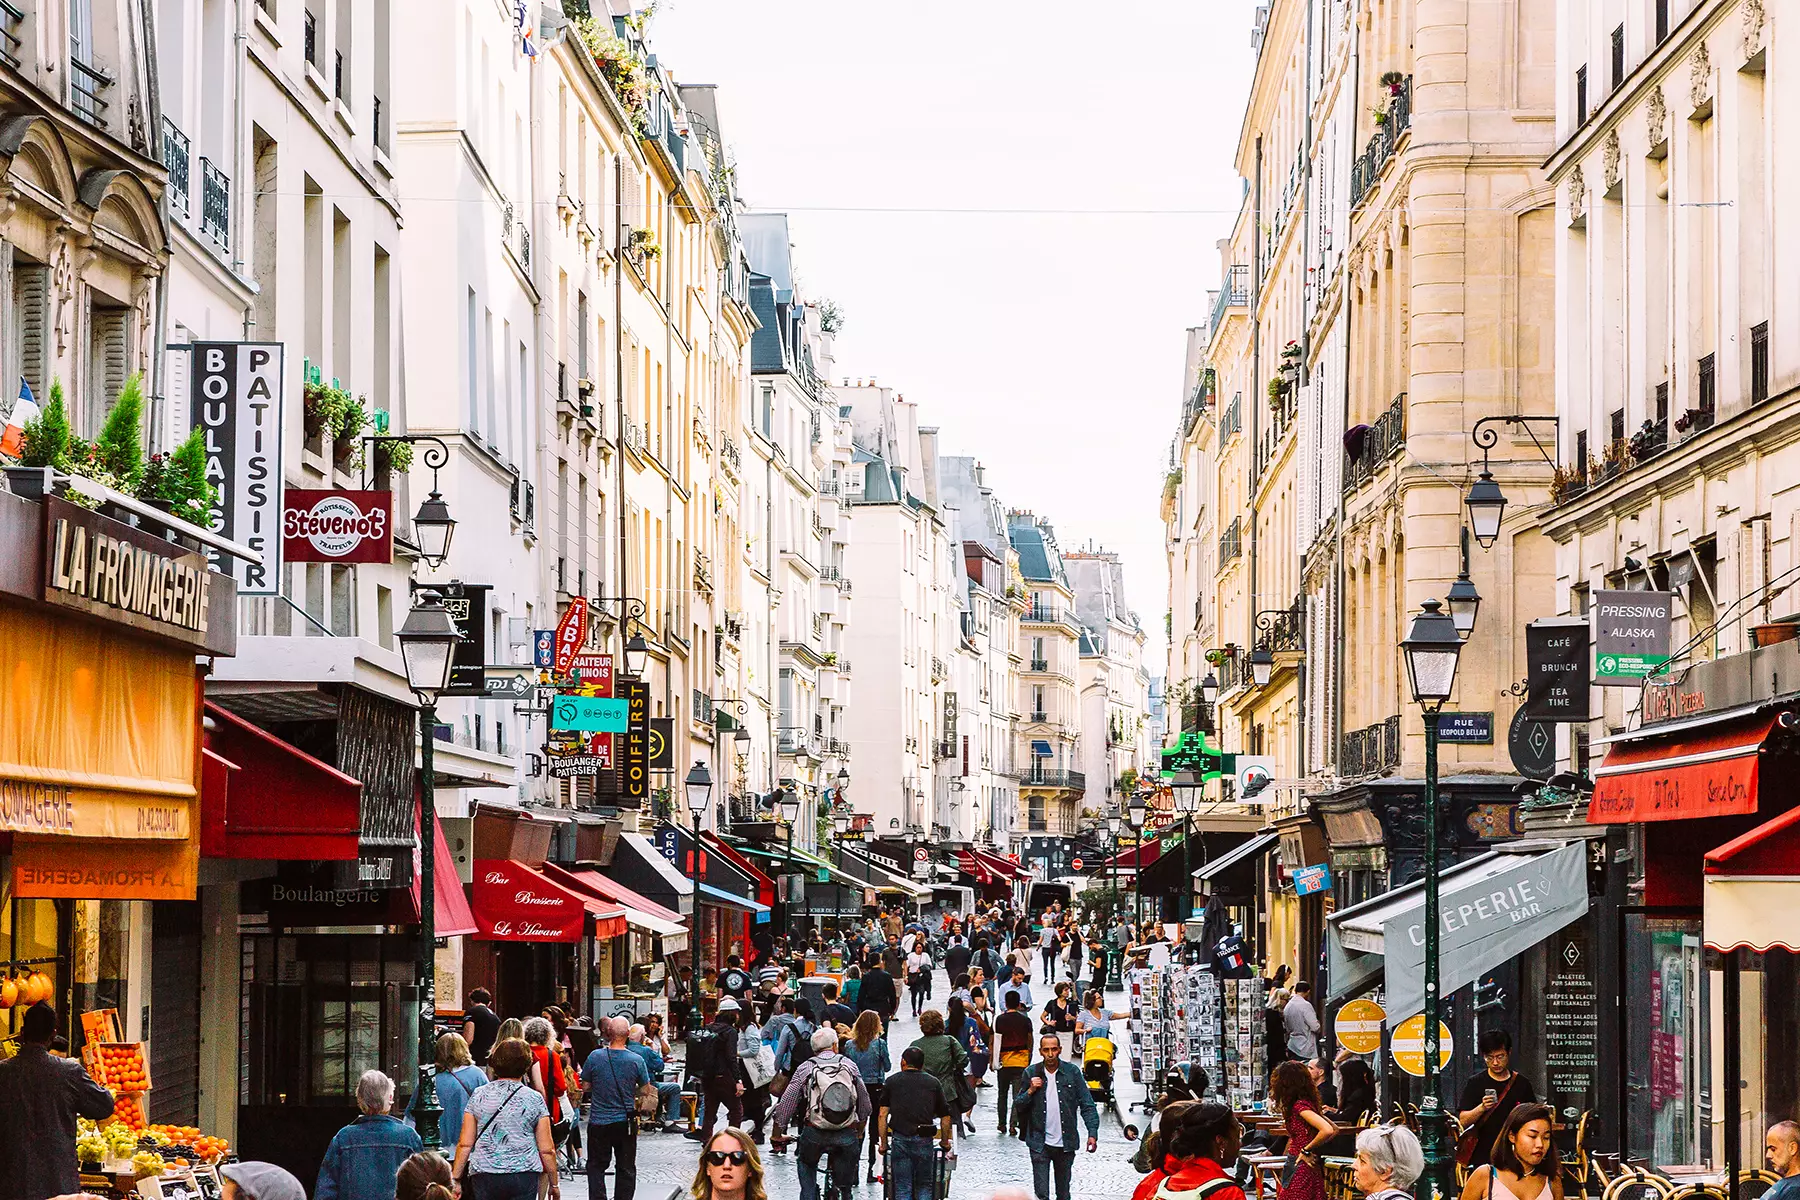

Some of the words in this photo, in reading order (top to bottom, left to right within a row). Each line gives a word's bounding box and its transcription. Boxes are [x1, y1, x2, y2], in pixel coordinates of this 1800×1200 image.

[319, 540, 353, 551] TRAITEUR
[53, 519, 85, 595] LA
[90, 533, 211, 633] FROMAGERIE
[1600, 605, 1666, 618] PRESSING
[560, 604, 582, 666] TABAC
[1611, 627, 1656, 638] ALASKA
[1547, 637, 1570, 647] CAFÉ
[572, 657, 612, 667] RAITEUR
[1541, 663, 1578, 672] BRUNCH
[486, 679, 509, 689] FDJ
[1551, 688, 1568, 696] TEA
[1548, 698, 1570, 706] TIME
[1440, 728, 1464, 736] LEOPOLD
[1466, 728, 1488, 736] BELLAN
[1535, 733, 1542, 746] C
[598, 745, 608, 754] DE
[554, 757, 603, 768] BOULANGER
[556, 766, 598, 777] PATISSIER
[0, 780, 73, 829] OMAGERIE
[1157, 817, 1173, 826] BAR
[665, 832, 676, 865] GROM
[485, 871, 510, 885] Bar
[1307, 880, 1321, 892] ICI
[272, 884, 380, 907] Boulangerie
[514, 890, 564, 906] Brasserie
[1408, 880, 1536, 947] CÊPERIE
[1509, 902, 1541, 923] BAR
[492, 920, 512, 936] Le
[517, 921, 563, 937] Havane
[1216, 943, 1240, 958] FRANCE
[1546, 992, 1568, 1000] CRÊPES
